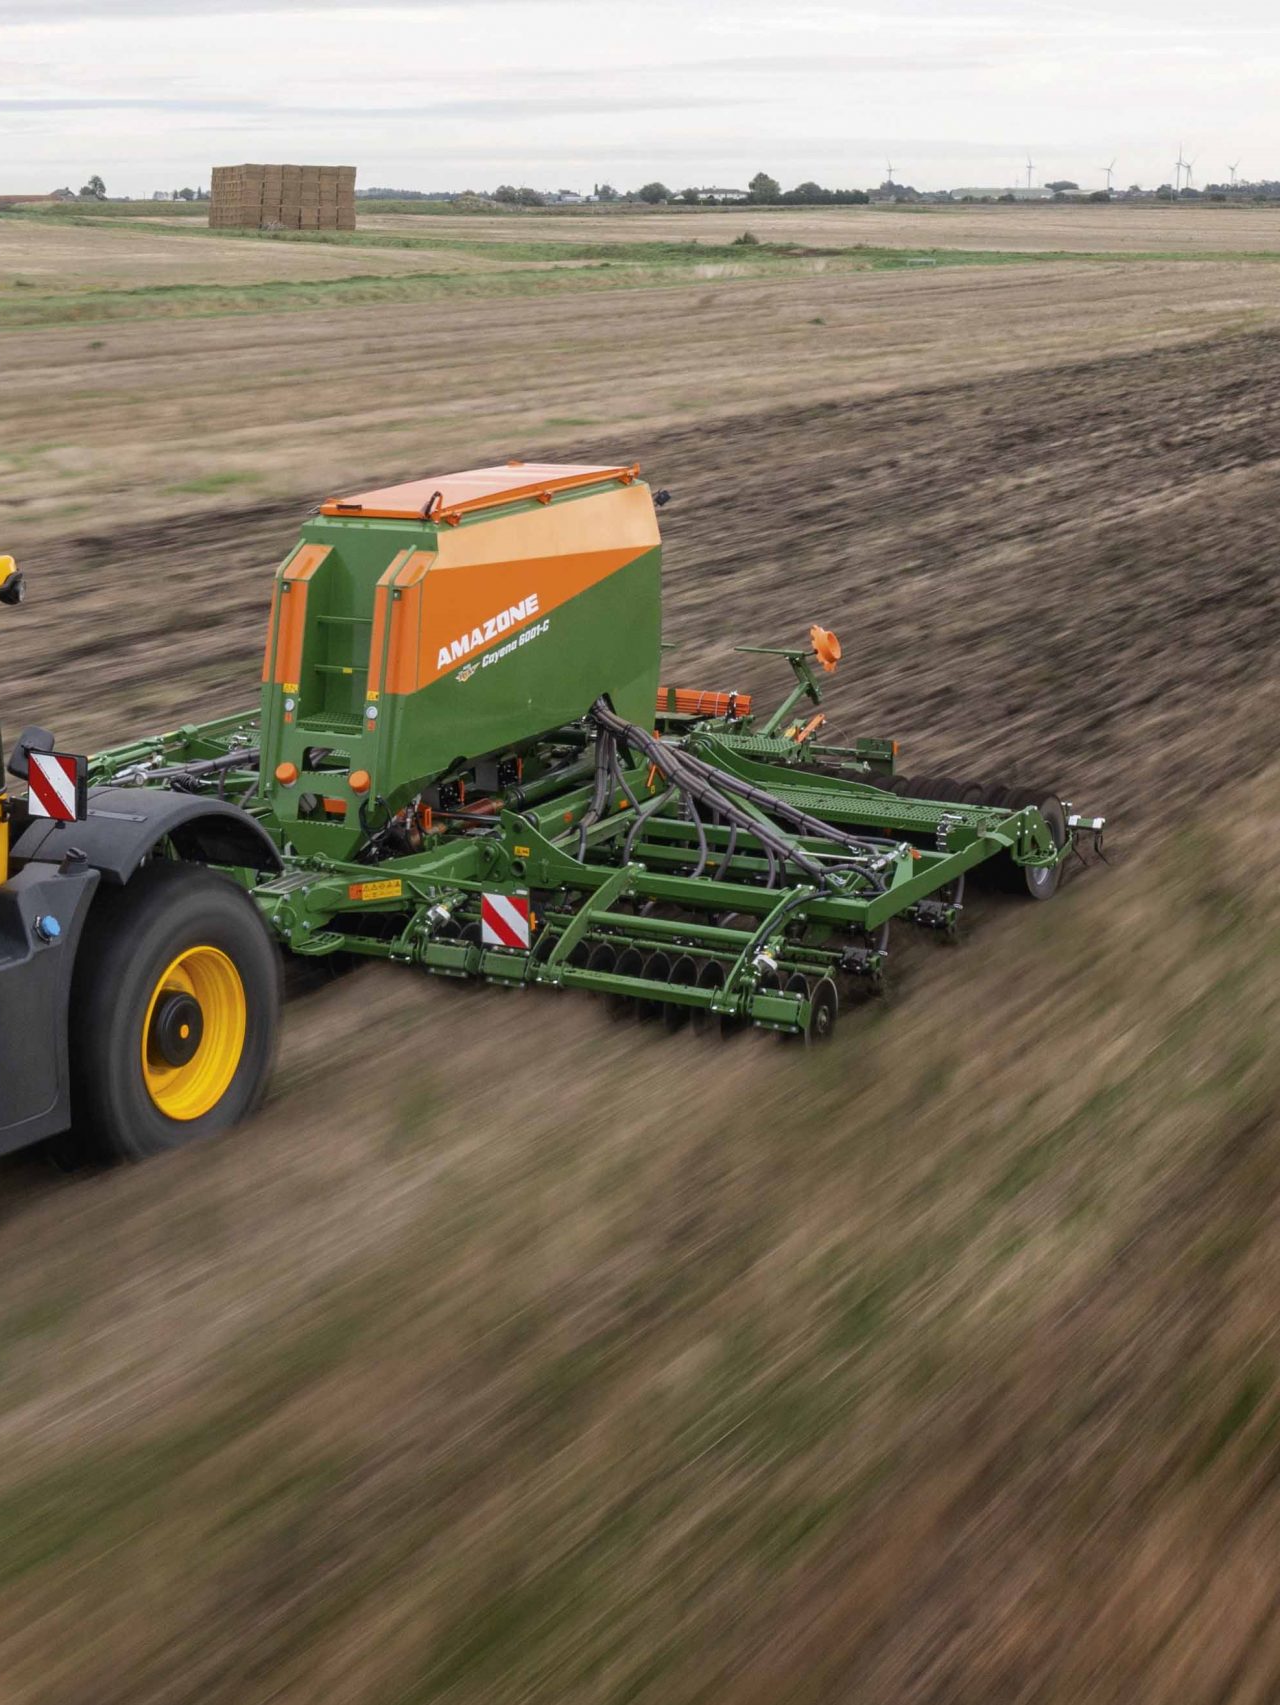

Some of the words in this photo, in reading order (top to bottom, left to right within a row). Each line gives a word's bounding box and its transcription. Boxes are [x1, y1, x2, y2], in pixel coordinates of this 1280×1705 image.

[437, 593, 539, 670] AMAZONE
[482, 639, 517, 667] Cayena
[518, 619, 550, 647] 6001-C
